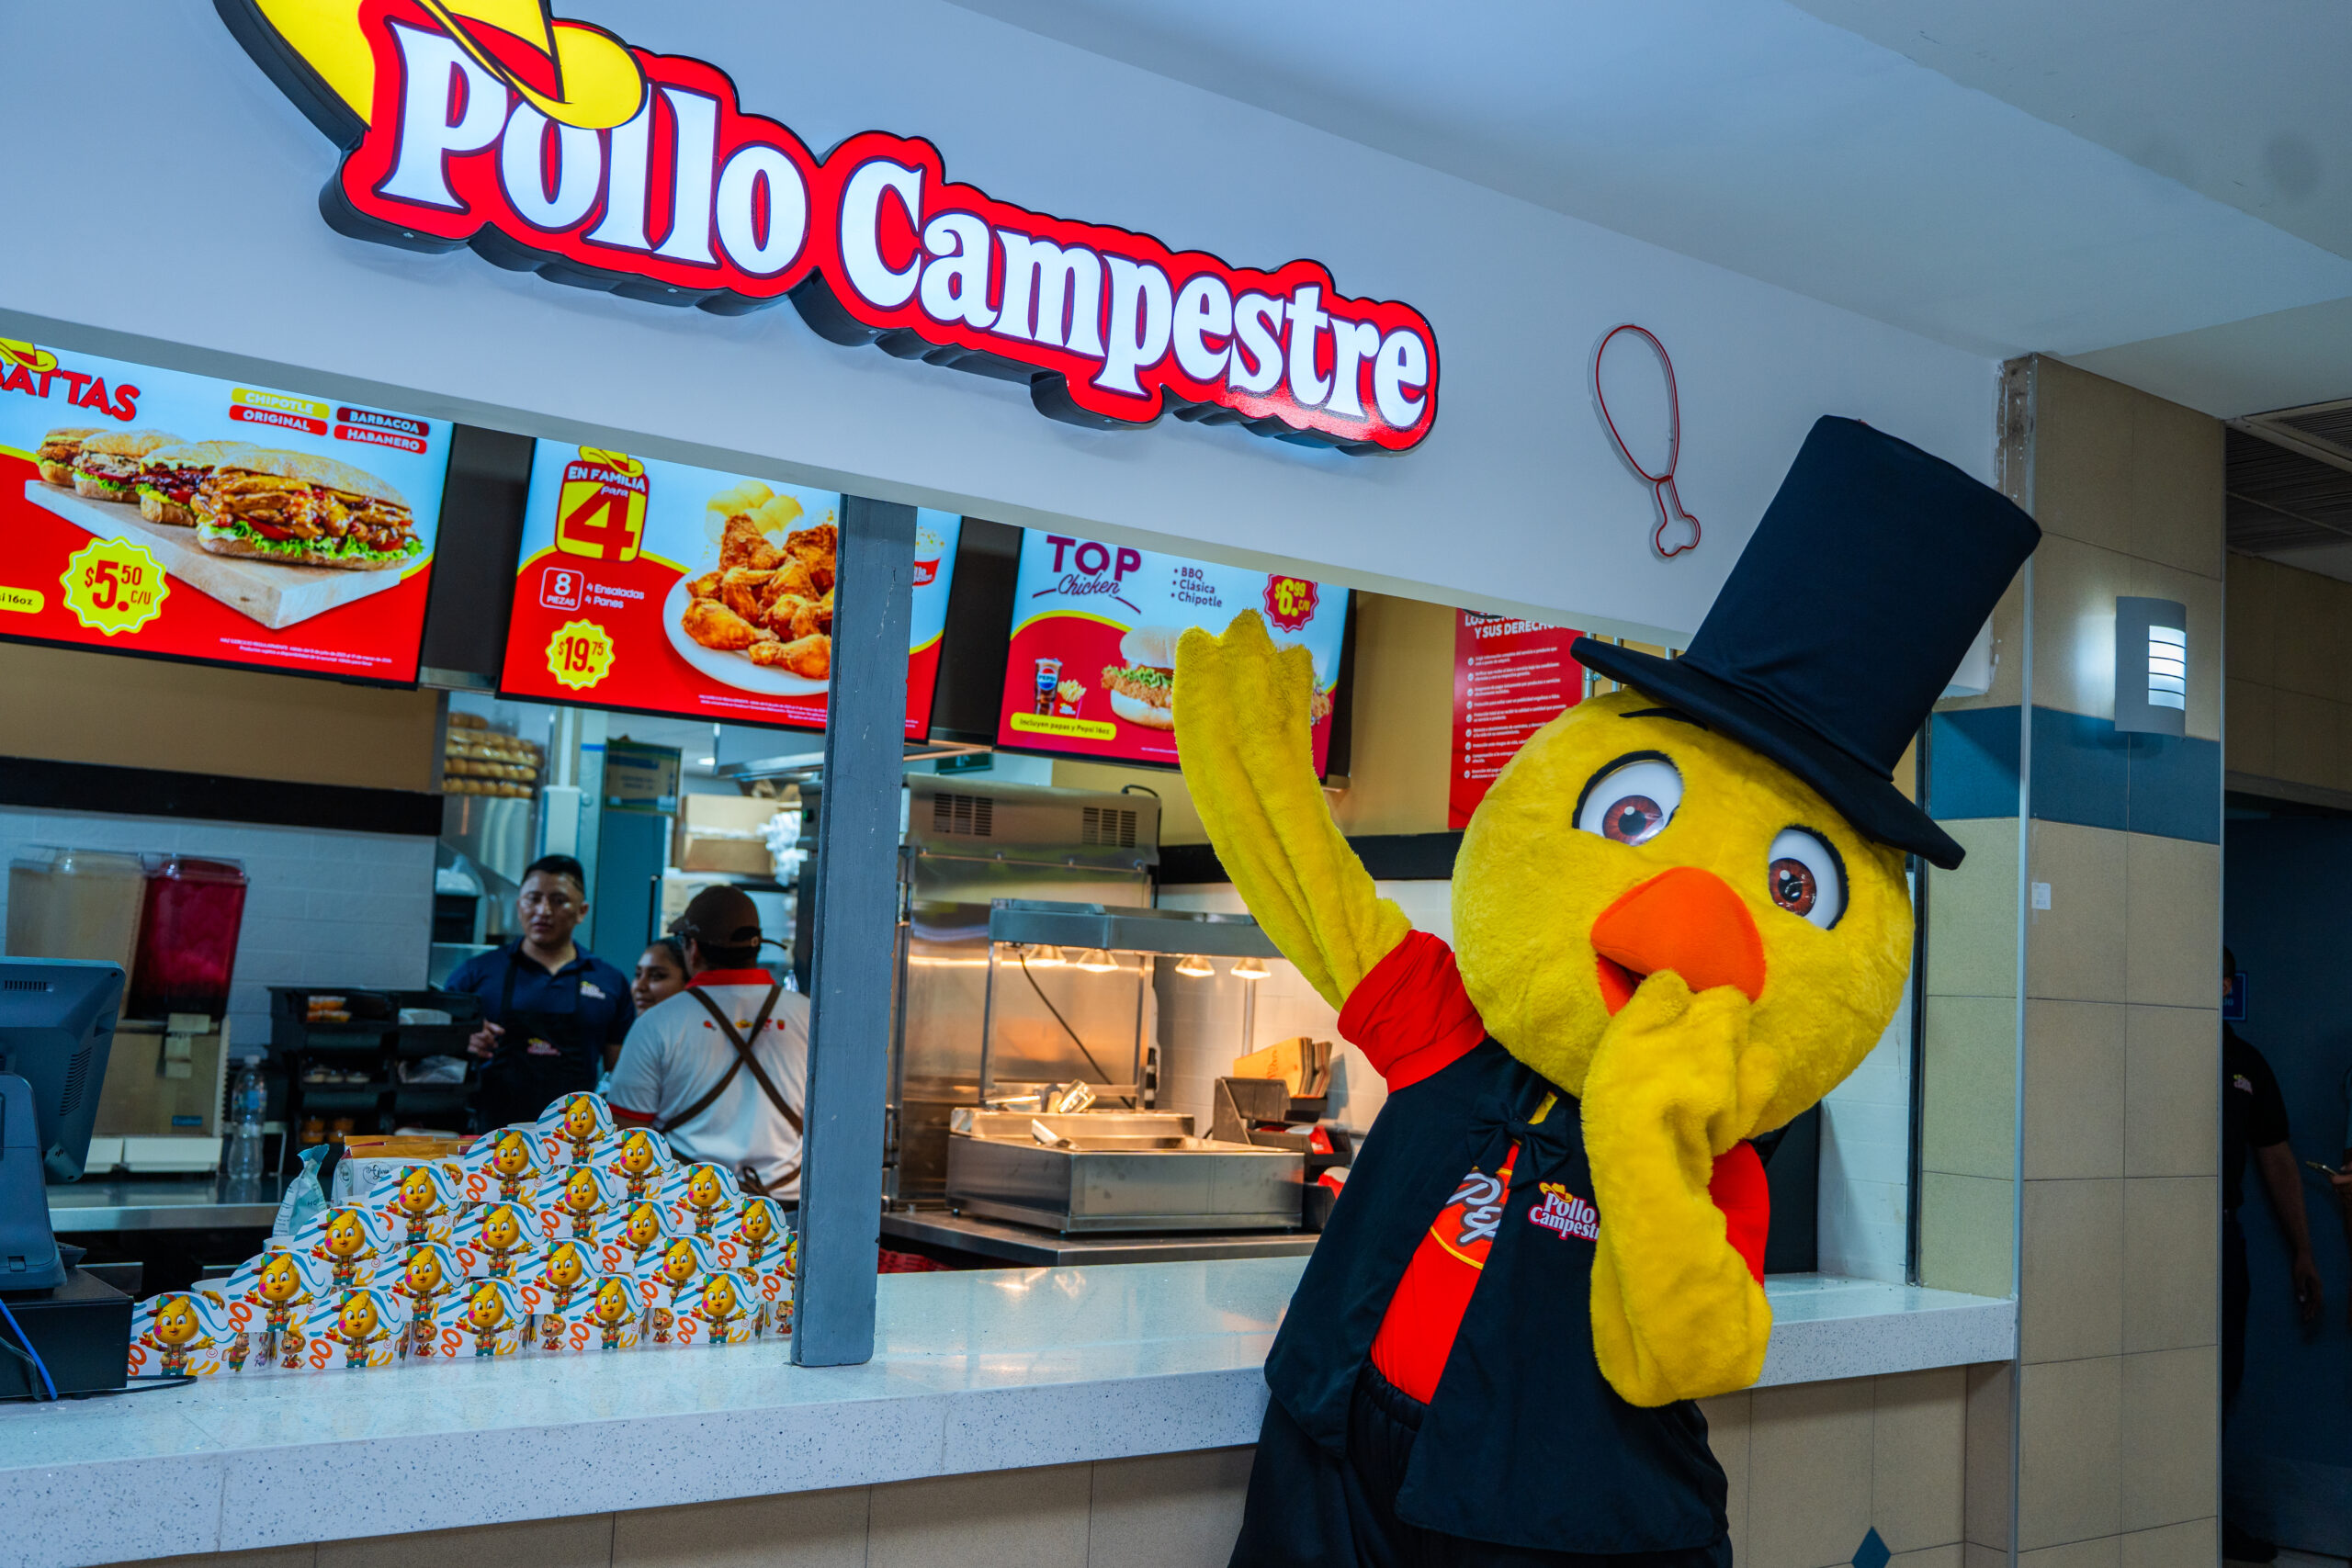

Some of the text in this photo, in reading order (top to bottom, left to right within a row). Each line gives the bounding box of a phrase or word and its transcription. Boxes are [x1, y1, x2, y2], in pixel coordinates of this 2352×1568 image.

[379, 21, 1428, 427] Pollo Campestre
[244, 392, 315, 414] CHIPOTLE
[243, 410, 311, 432] ORIGINAL
[349, 411, 420, 434] BARBACOA
[346, 429, 420, 451] HABANERO
[568, 466, 646, 492] EN FAMILIA
[600, 485, 629, 498] para
[563, 483, 635, 561] 4
[1046, 535, 1142, 582] TOP
[554, 572, 571, 596] 8
[1057, 572, 1121, 596] Chicken
[1181, 567, 1204, 581] BBQ
[130, 590, 152, 605] C/U
[594, 583, 645, 601] Ensaladas
[1179, 580, 1216, 594] Clásica
[8, 594, 34, 605] 16oz
[547, 595, 576, 606] PIEZAS
[593, 595, 625, 609] Panes
[1177, 592, 1223, 608] Chipotle
[1475, 627, 1482, 639] Y
[1482, 625, 1503, 638] SUS
[1544, 1192, 1596, 1224] Pollo
